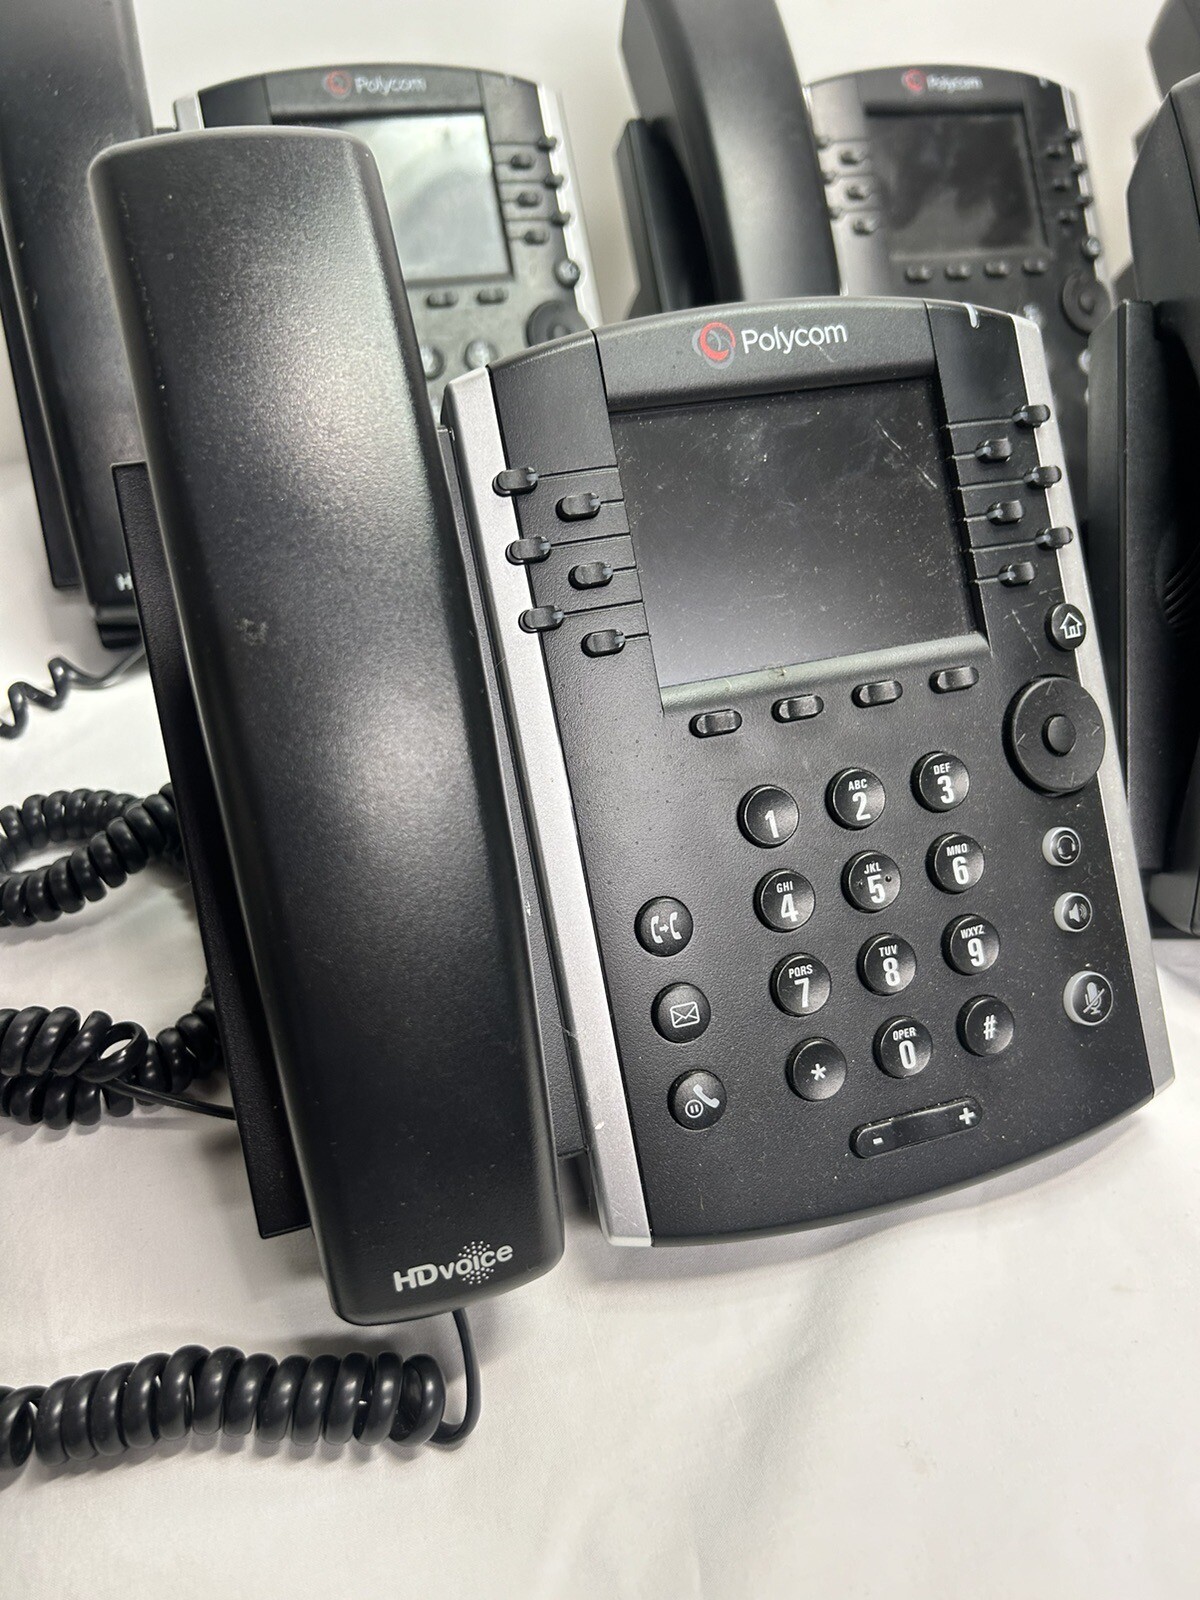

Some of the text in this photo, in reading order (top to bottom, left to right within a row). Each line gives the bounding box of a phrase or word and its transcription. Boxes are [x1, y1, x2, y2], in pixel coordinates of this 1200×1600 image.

[740, 323, 848, 355] Polycom
[933, 762, 951, 775] DEF
[848, 779, 868, 791] ABC
[937, 775, 954, 804] 3
[852, 791, 871, 821] 2
[764, 810, 779, 838] 1
[946, 843, 968, 857] MNO
[863, 862, 882, 875] JKL
[952, 856, 969, 885] 6
[776, 881, 794, 892] GHI
[867, 874, 886, 903] 5
[780, 893, 799, 922] 4
[960, 924, 985, 939] WXYZ
[878, 945, 898, 957] TUV
[967, 938, 985, 967] 9
[788, 964, 813, 979] PQRS
[882, 957, 901, 987] 8
[794, 977, 811, 1008] 7
[892, 1027, 916, 1041] OPER
[898, 1040, 916, 1069] 0
[393, 1244, 514, 1292] HDvoice
